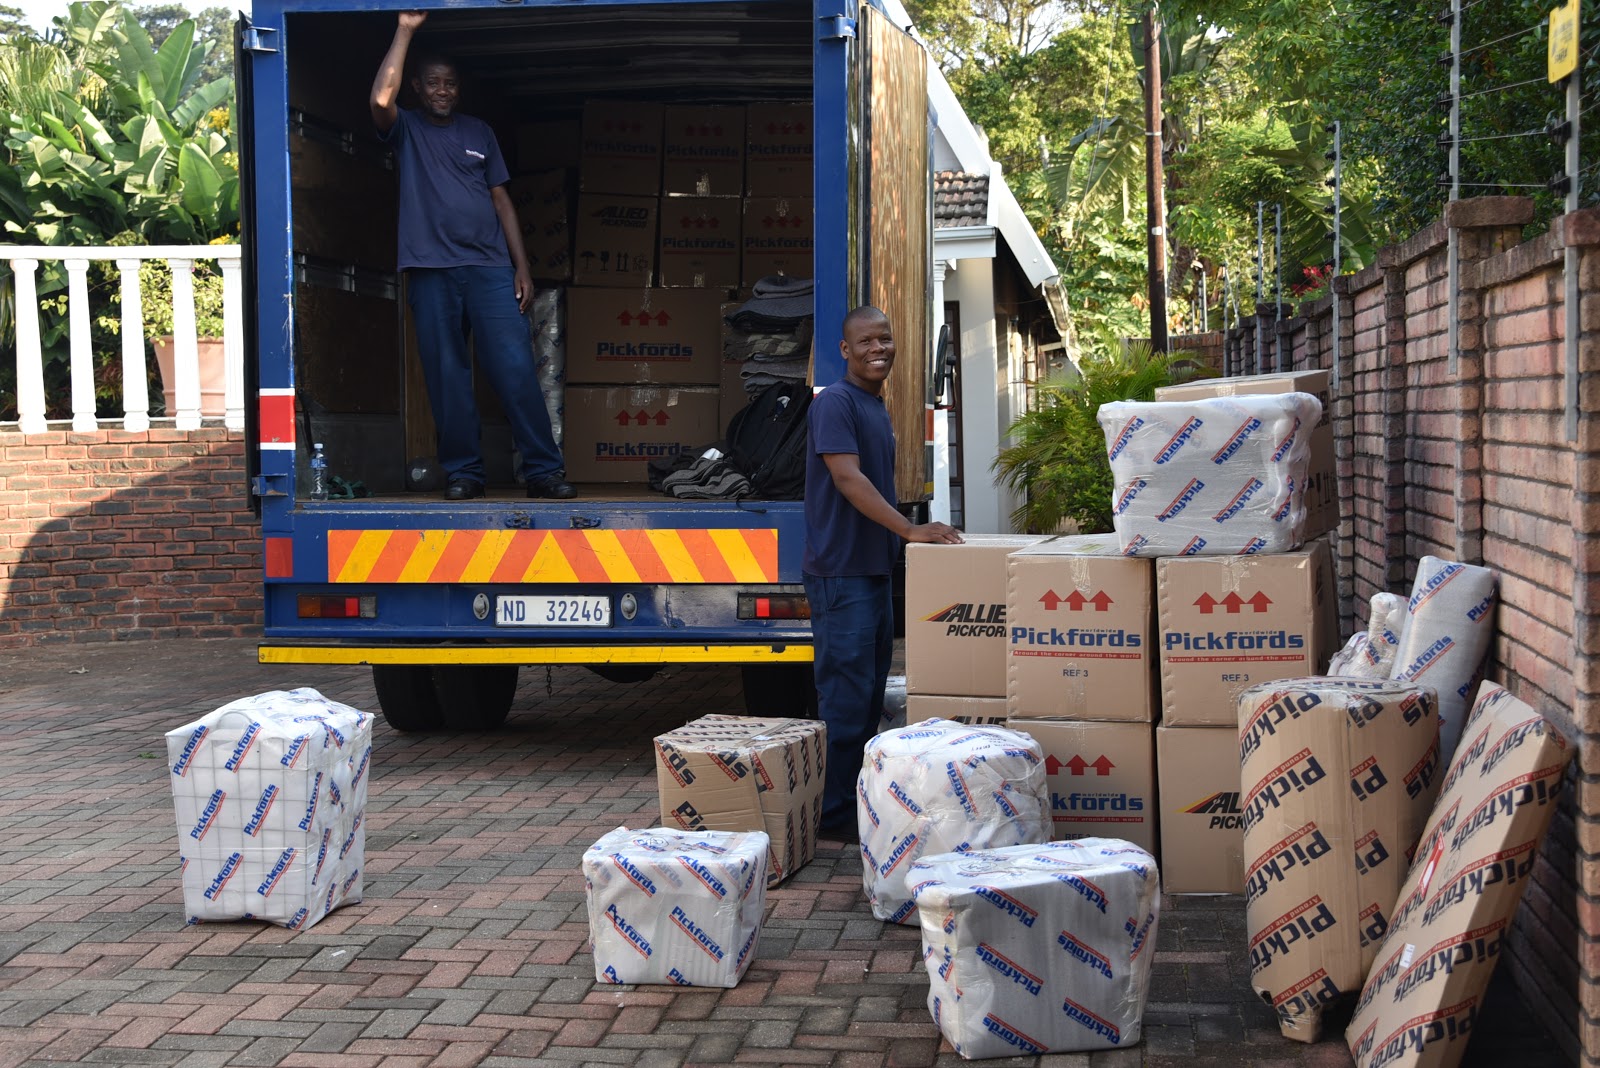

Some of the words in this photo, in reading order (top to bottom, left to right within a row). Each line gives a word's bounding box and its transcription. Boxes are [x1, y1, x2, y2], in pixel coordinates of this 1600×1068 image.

[663, 237, 736, 249] Pickfords
[597, 342, 693, 356] Pickfords
[1156, 418, 1203, 464] Pickfords
[1215, 418, 1261, 465] Pickfords
[503, 600, 526, 622] ND
[546, 600, 603, 622] 32246
[945, 603, 1006, 623] ALLIE
[946, 624, 1006, 638] PICKFOR
[1012, 627, 1141, 647] Pickfords
[1165, 631, 1304, 650] Pickfords
[1396, 635, 1452, 681] ickfords
[1062, 669, 1080, 677] REF
[1083, 669, 1089, 677] 3
[1222, 674, 1241, 682] REF
[1243, 674, 1249, 682] 3
[173, 725, 206, 775] Pickfords
[225, 722, 260, 772] Pickfords
[1280, 750, 1309, 771] Around
[190, 788, 223, 840] Pickfords
[244, 784, 276, 836] Pickfords
[890, 781, 923, 814] Pickfor
[1052, 793, 1143, 811] kfords
[880, 833, 916, 875] Pickfords
[1285, 824, 1314, 845] Around
[204, 852, 240, 900] Pickfords
[257, 847, 294, 896] Pickfords
[1421, 848, 1535, 928] Pickfords
[1289, 896, 1318, 918] Around
[607, 903, 653, 957] Pckfords
[672, 906, 724, 960] Pickfords
[976, 945, 1042, 997] Pickfords
[1295, 970, 1323, 991] Around
[1393, 927, 1505, 1003] Pickfords
[1062, 1002, 1121, 1045] Pickfords
